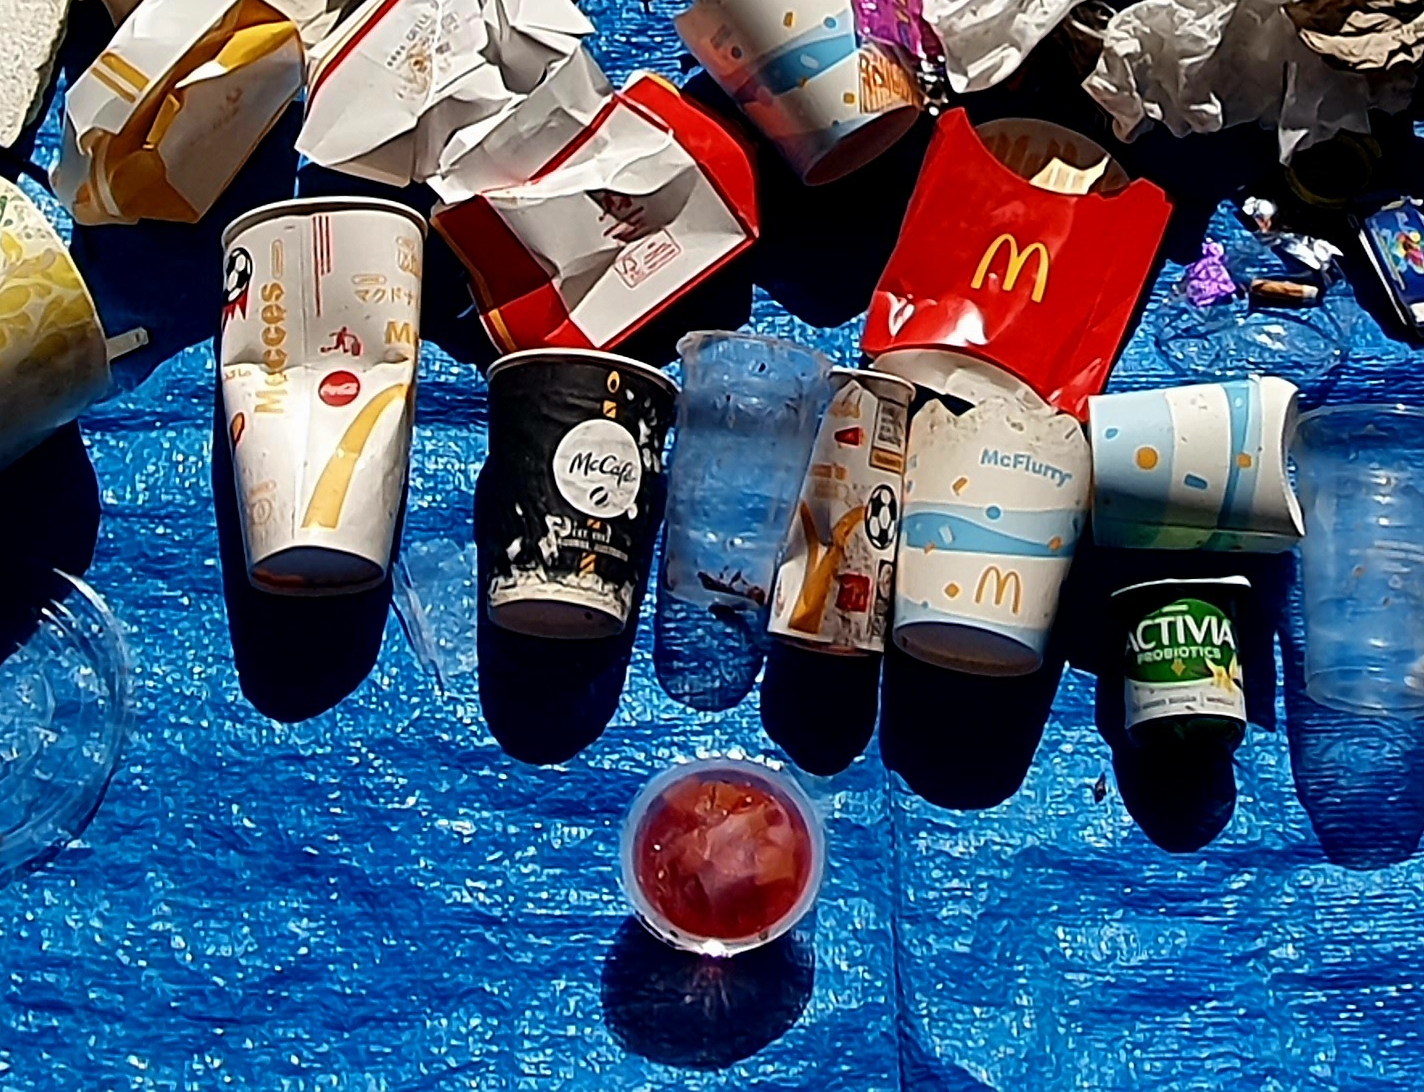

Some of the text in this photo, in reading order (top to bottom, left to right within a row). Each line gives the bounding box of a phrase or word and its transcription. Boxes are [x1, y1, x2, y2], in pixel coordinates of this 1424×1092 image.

[979, 448, 1073, 489] McFlurry
[1124, 613, 1237, 654] ACTIVIA
[1136, 644, 1222, 665] PROBIOTICS
